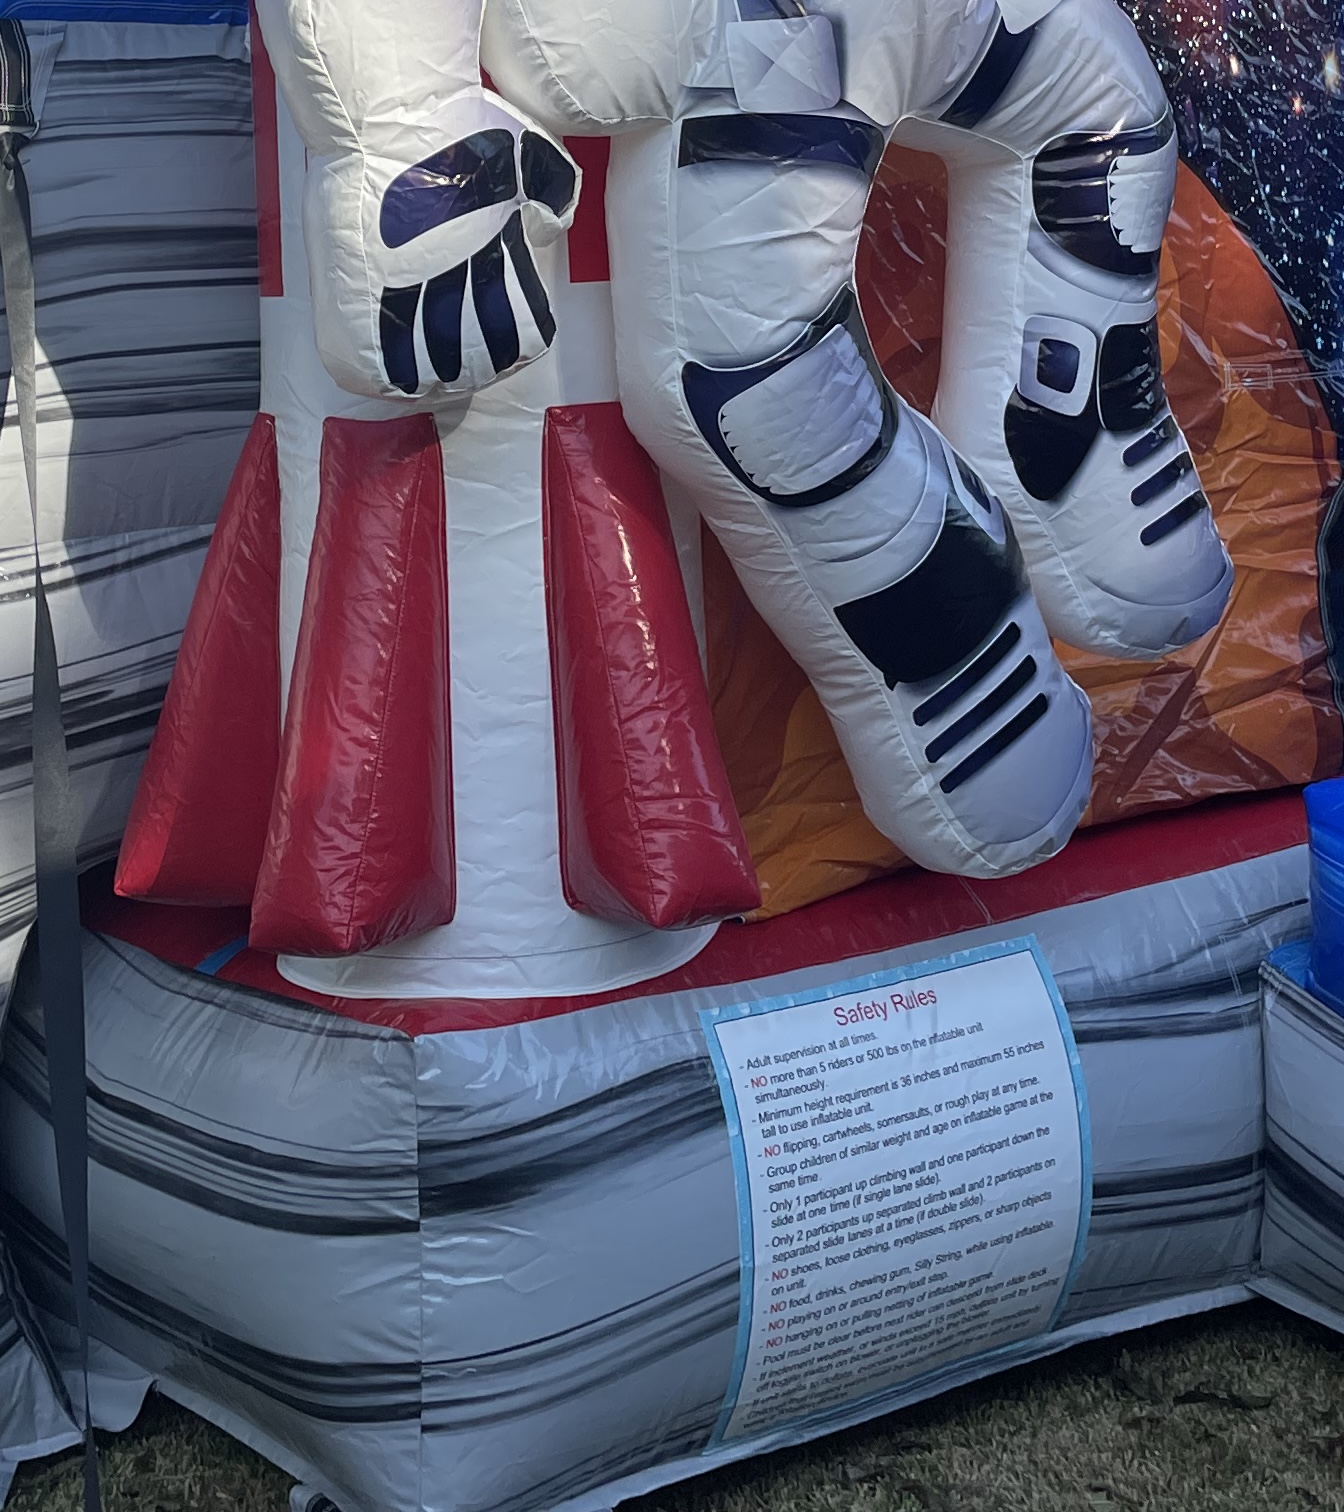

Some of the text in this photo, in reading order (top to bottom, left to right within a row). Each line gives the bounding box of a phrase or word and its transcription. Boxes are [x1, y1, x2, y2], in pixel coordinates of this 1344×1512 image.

[833, 989, 937, 1026] Safety Rules
[746, 1054, 772, 1070] Adult
[773, 1044, 826, 1064] supervision
[827, 1039, 838, 1050] at
[838, 1035, 850, 1048] all
[750, 1075, 768, 1088] NO
[769, 1071, 794, 1084] more
[795, 1065, 818, 1078] than
[818, 1061, 826, 1072] 5
[827, 1056, 854, 1070] riders
[855, 1053, 864, 1063] or
[866, 1047, 884, 1060] 500
[884, 1045, 899, 1055] lbs
[900, 1042, 912, 1052] on
[911, 1038, 927, 1048] the
[965, 1021, 984, 1034] unit
[758, 1040, 1044, 1123] Minimum height requirement is 36 inches and maximum 55 inches
[761, 1101, 874, 1138] tall to use inflatable unit.
[763, 1143, 781, 1158] NO
[933, 1102, 942, 1113] or
[944, 1093, 970, 1110] rough
[970, 1089, 989, 1104] play
[991, 1085, 1000, 1096] at
[1001, 1082, 1017, 1093] any
[766, 1091, 1053, 1177] Group children of similar weight and age on inflatable game at the
[768, 1179, 795, 1193] same
[769, 1126, 1049, 1213] Only 1 participant up climbing wall and one participant down the
[771, 1158, 1055, 1247] Only 2 participants up separated climb wall and 2 participants on
[771, 1213, 794, 1228] slide
[796, 1209, 806, 1221] at
[807, 1206, 826, 1218] one
[829, 1199, 850, 1212] time
[852, 1193, 861, 1208] (if
[863, 1187, 891, 1203] single
[892, 1182, 912, 1194] lane
[771, 1239, 820, 1263] separated
[822, 1234, 844, 1249] slide
[847, 1227, 873, 1242] lanes
[874, 1222, 884, 1234] at
[886, 1221, 892, 1231] a
[894, 1215, 914, 1228] time
[916, 1209, 925, 1224] (if
[927, 1201, 957, 1219] double
[771, 1267, 788, 1282] NO
[824, 1252, 850, 1267] loose
[984, 1209, 994, 1219] or
[995, 1201, 1020, 1215] sharp
[1021, 1190, 1052, 1207] objects
[769, 1300, 787, 1314] NO
[770, 1285, 784, 1296] on
[765, 1335, 783, 1349] NO
[767, 1318, 785, 1332] NO
